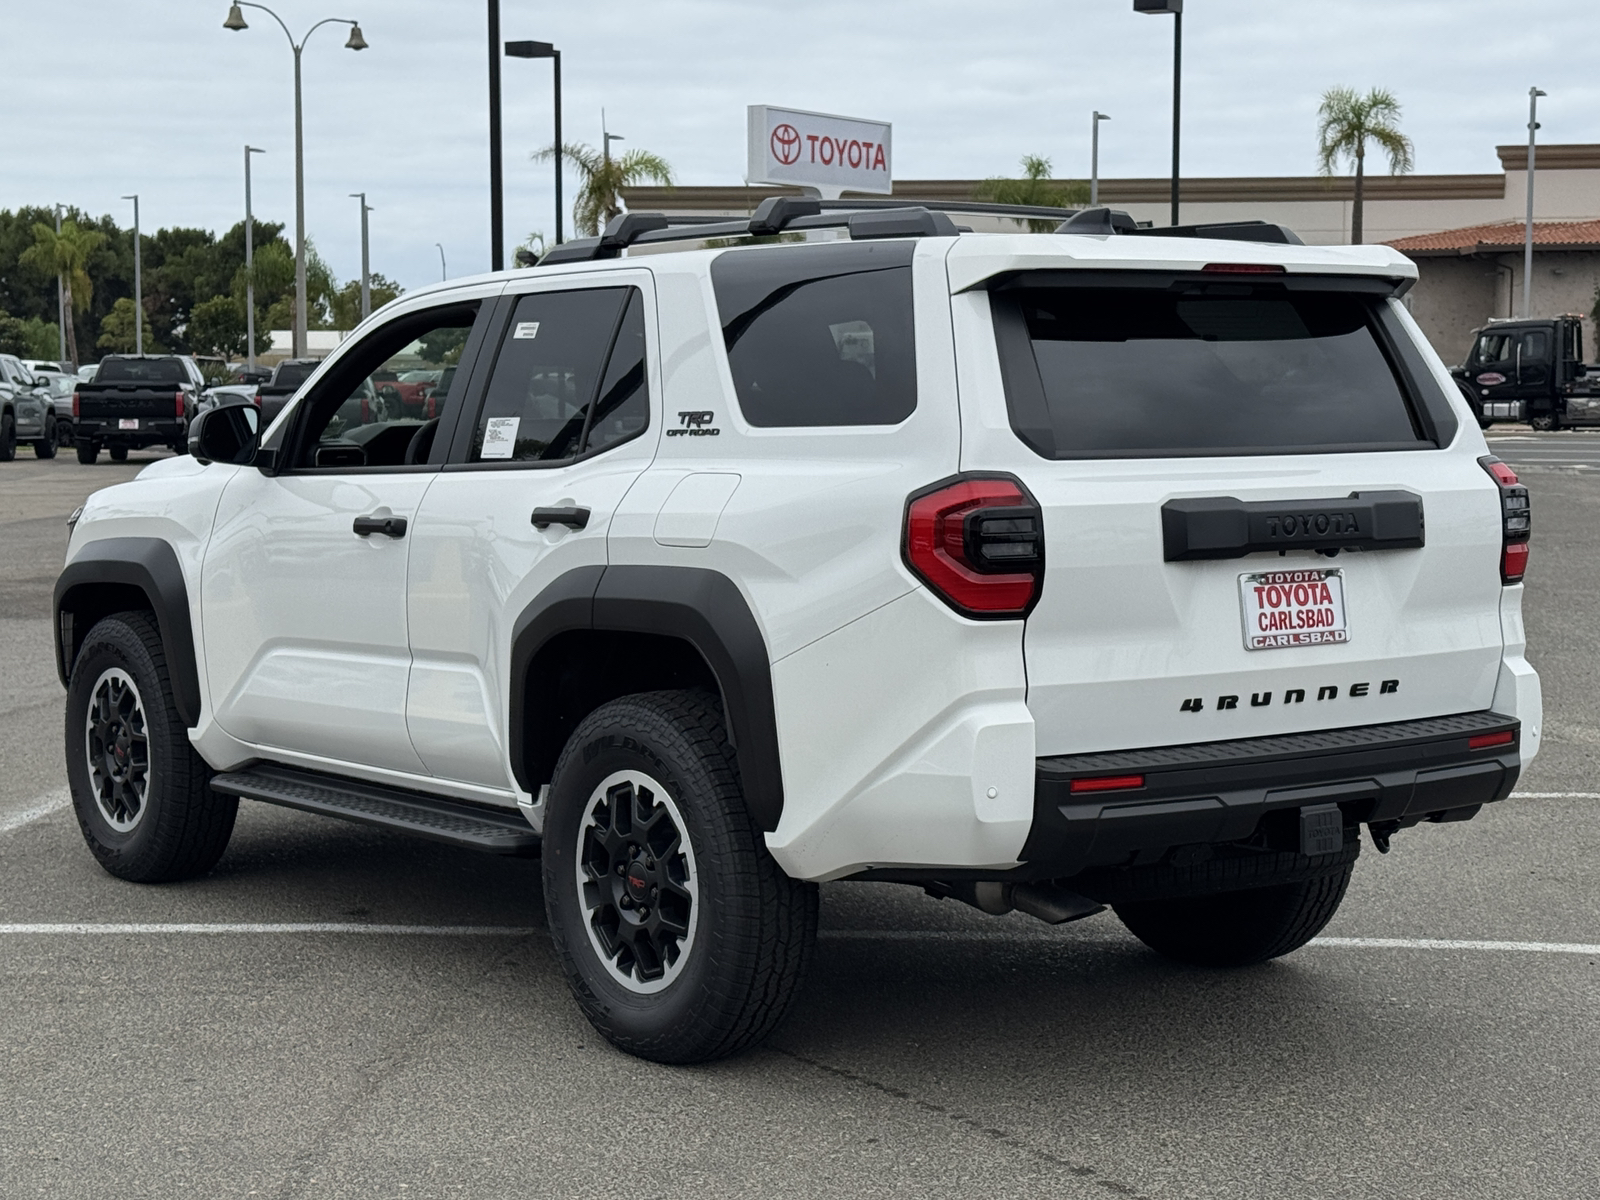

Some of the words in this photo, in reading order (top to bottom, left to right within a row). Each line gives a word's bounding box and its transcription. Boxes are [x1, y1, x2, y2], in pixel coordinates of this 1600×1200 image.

[806, 134, 887, 172] TOYOTA
[677, 410, 715, 429] TRD
[666, 429, 688, 437] OFF
[689, 428, 720, 437] ROAD
[1266, 512, 1360, 538] TOYOTA
[1266, 570, 1320, 584] TOYOTA
[1253, 582, 1333, 609] TOYOTA
[1257, 607, 1335, 632] CARLSBAD
[1251, 630, 1347, 649] CARLSBAD
[1179, 679, 1400, 713] 4RUNNER
[1308, 826, 1341, 838] TOYOTA
